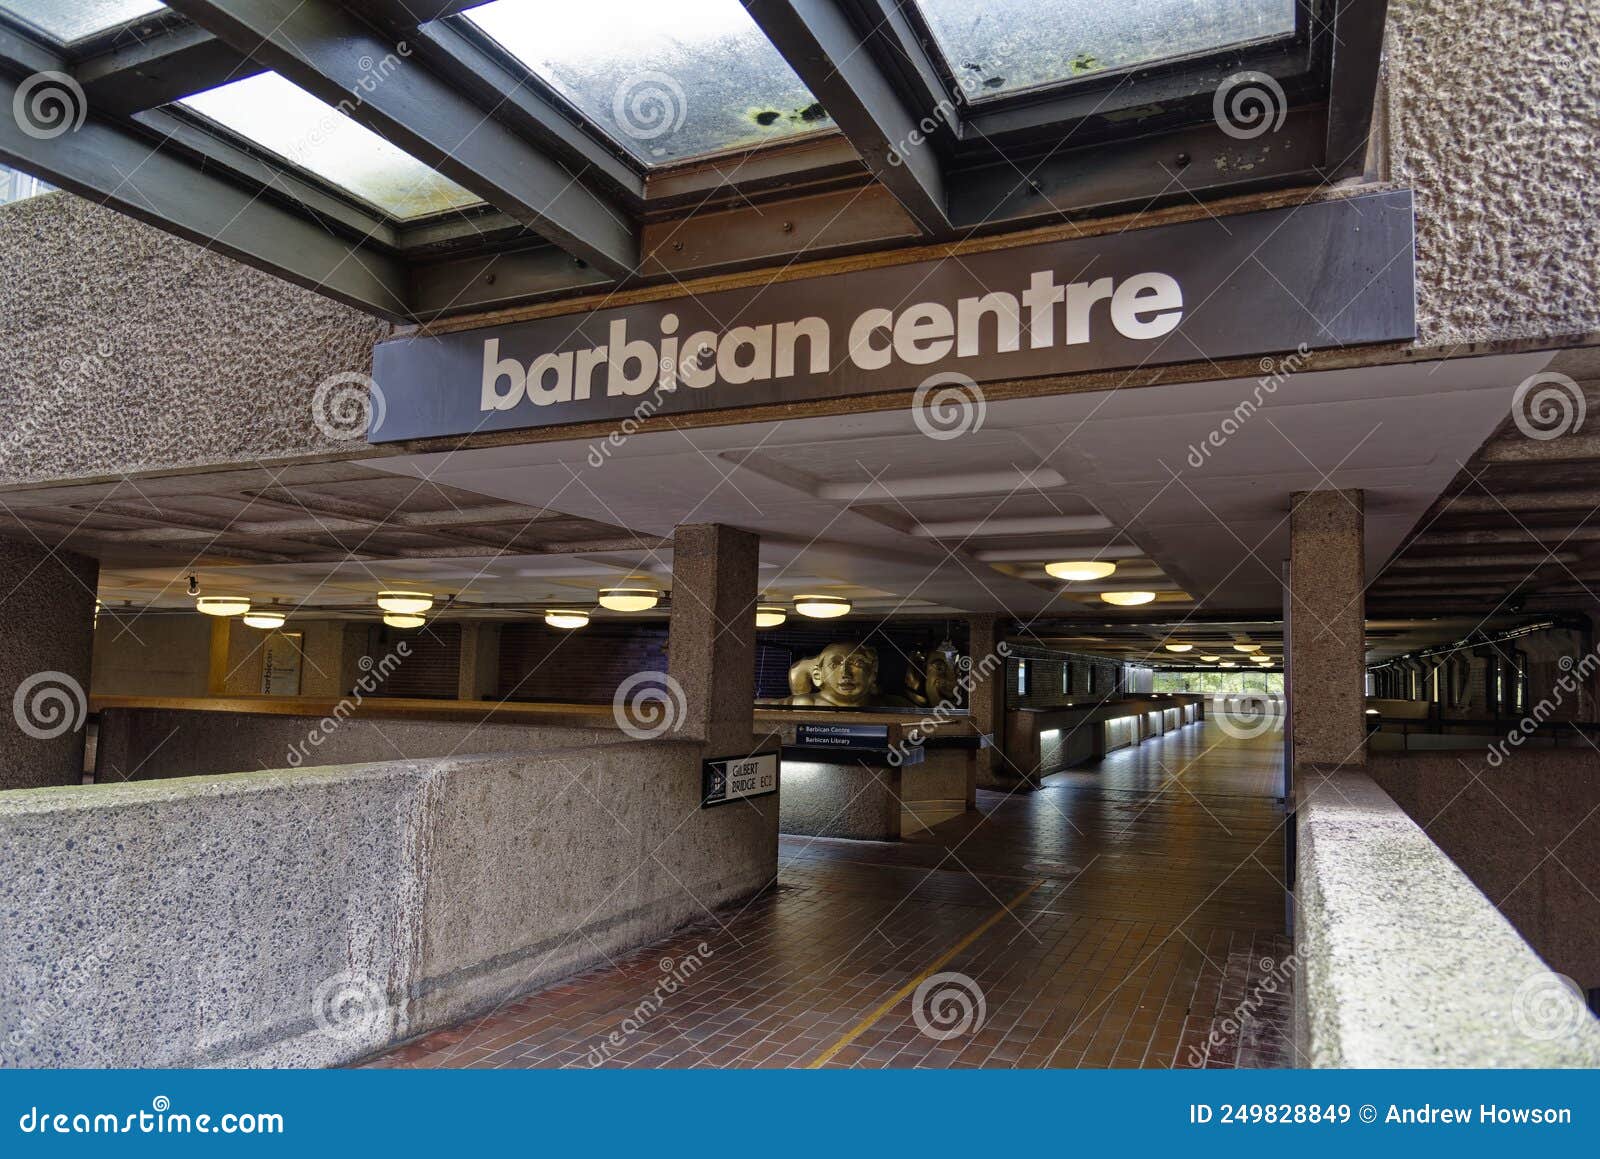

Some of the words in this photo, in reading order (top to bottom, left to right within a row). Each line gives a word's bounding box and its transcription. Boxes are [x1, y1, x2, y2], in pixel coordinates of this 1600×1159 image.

[480, 312, 830, 412] barbican
[848, 270, 1183, 370] centre
[830, 737, 850, 745] Library
[732, 762, 759, 777] GILBERT
[731, 778, 756, 793] BRIDGE
